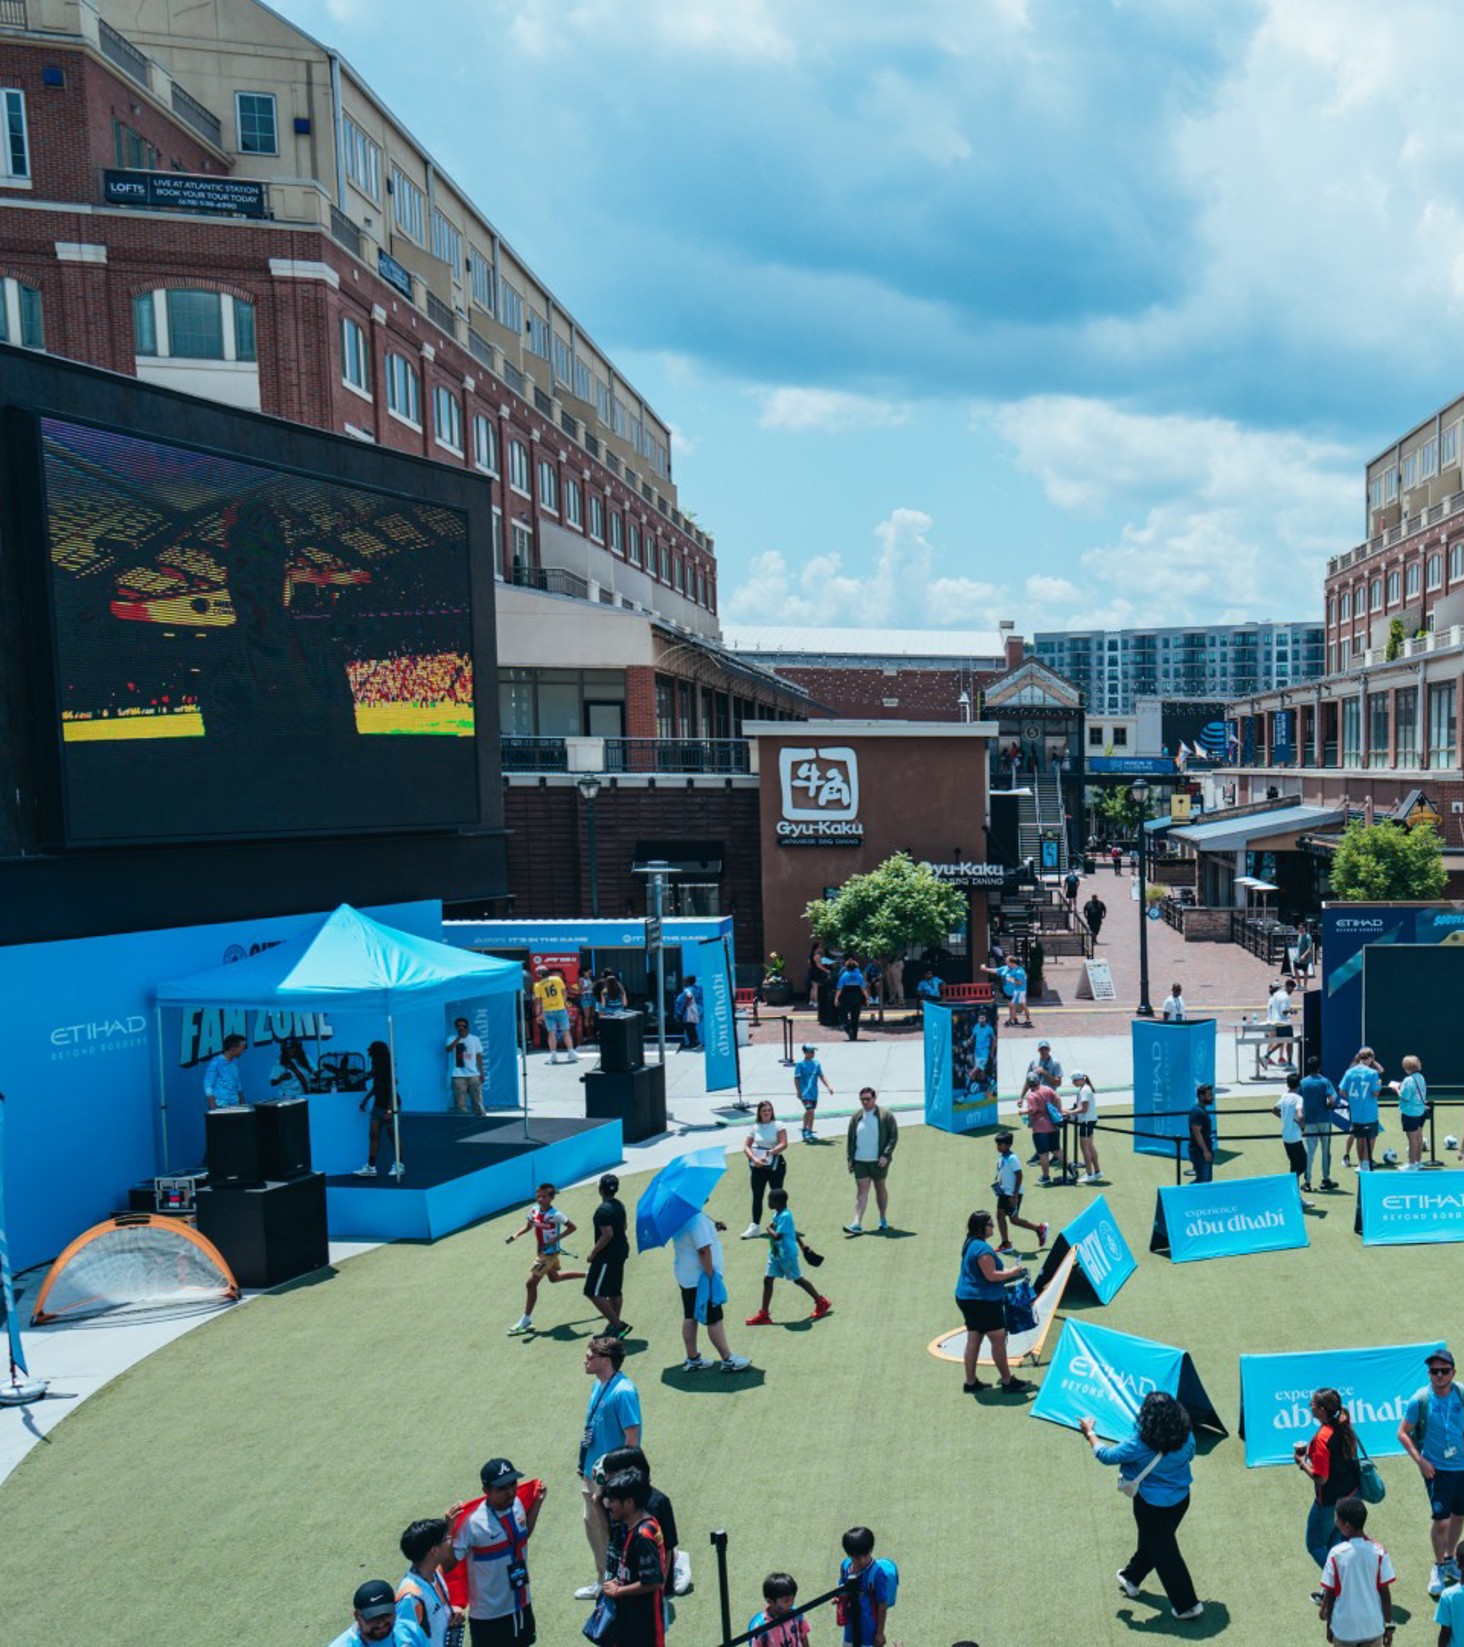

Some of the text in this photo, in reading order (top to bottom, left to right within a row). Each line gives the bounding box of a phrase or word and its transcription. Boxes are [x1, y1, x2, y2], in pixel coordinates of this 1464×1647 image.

[110, 182, 146, 193] LOFTS
[153, 179, 172, 187] LIVE
[184, 182, 224, 192] ATLANTIC
[225, 184, 259, 194] STATION
[156, 188, 258, 204] BOOK YOUR TOUR TODAY
[776, 821, 864, 838] Gyu-Kaku
[972, 877, 1004, 886] DINING
[1335, 918, 1384, 927] ETIHAD
[50, 1016, 147, 1046] ETIHAD
[180, 1007, 247, 1067] FAN
[51, 1045, 96, 1061] BEYOND
[1152, 1041, 1164, 1136] ETIHAD
[1349, 1081, 1370, 1100] 47
[1184, 1205, 1238, 1219] experience
[1382, 1212, 1427, 1221] BEYOND
[1185, 1208, 1286, 1238] abu dhabi
[1077, 1228, 1113, 1285] CITY
[1060, 1378, 1105, 1398] BEYOND
[1274, 1385, 1355, 1402] experce
